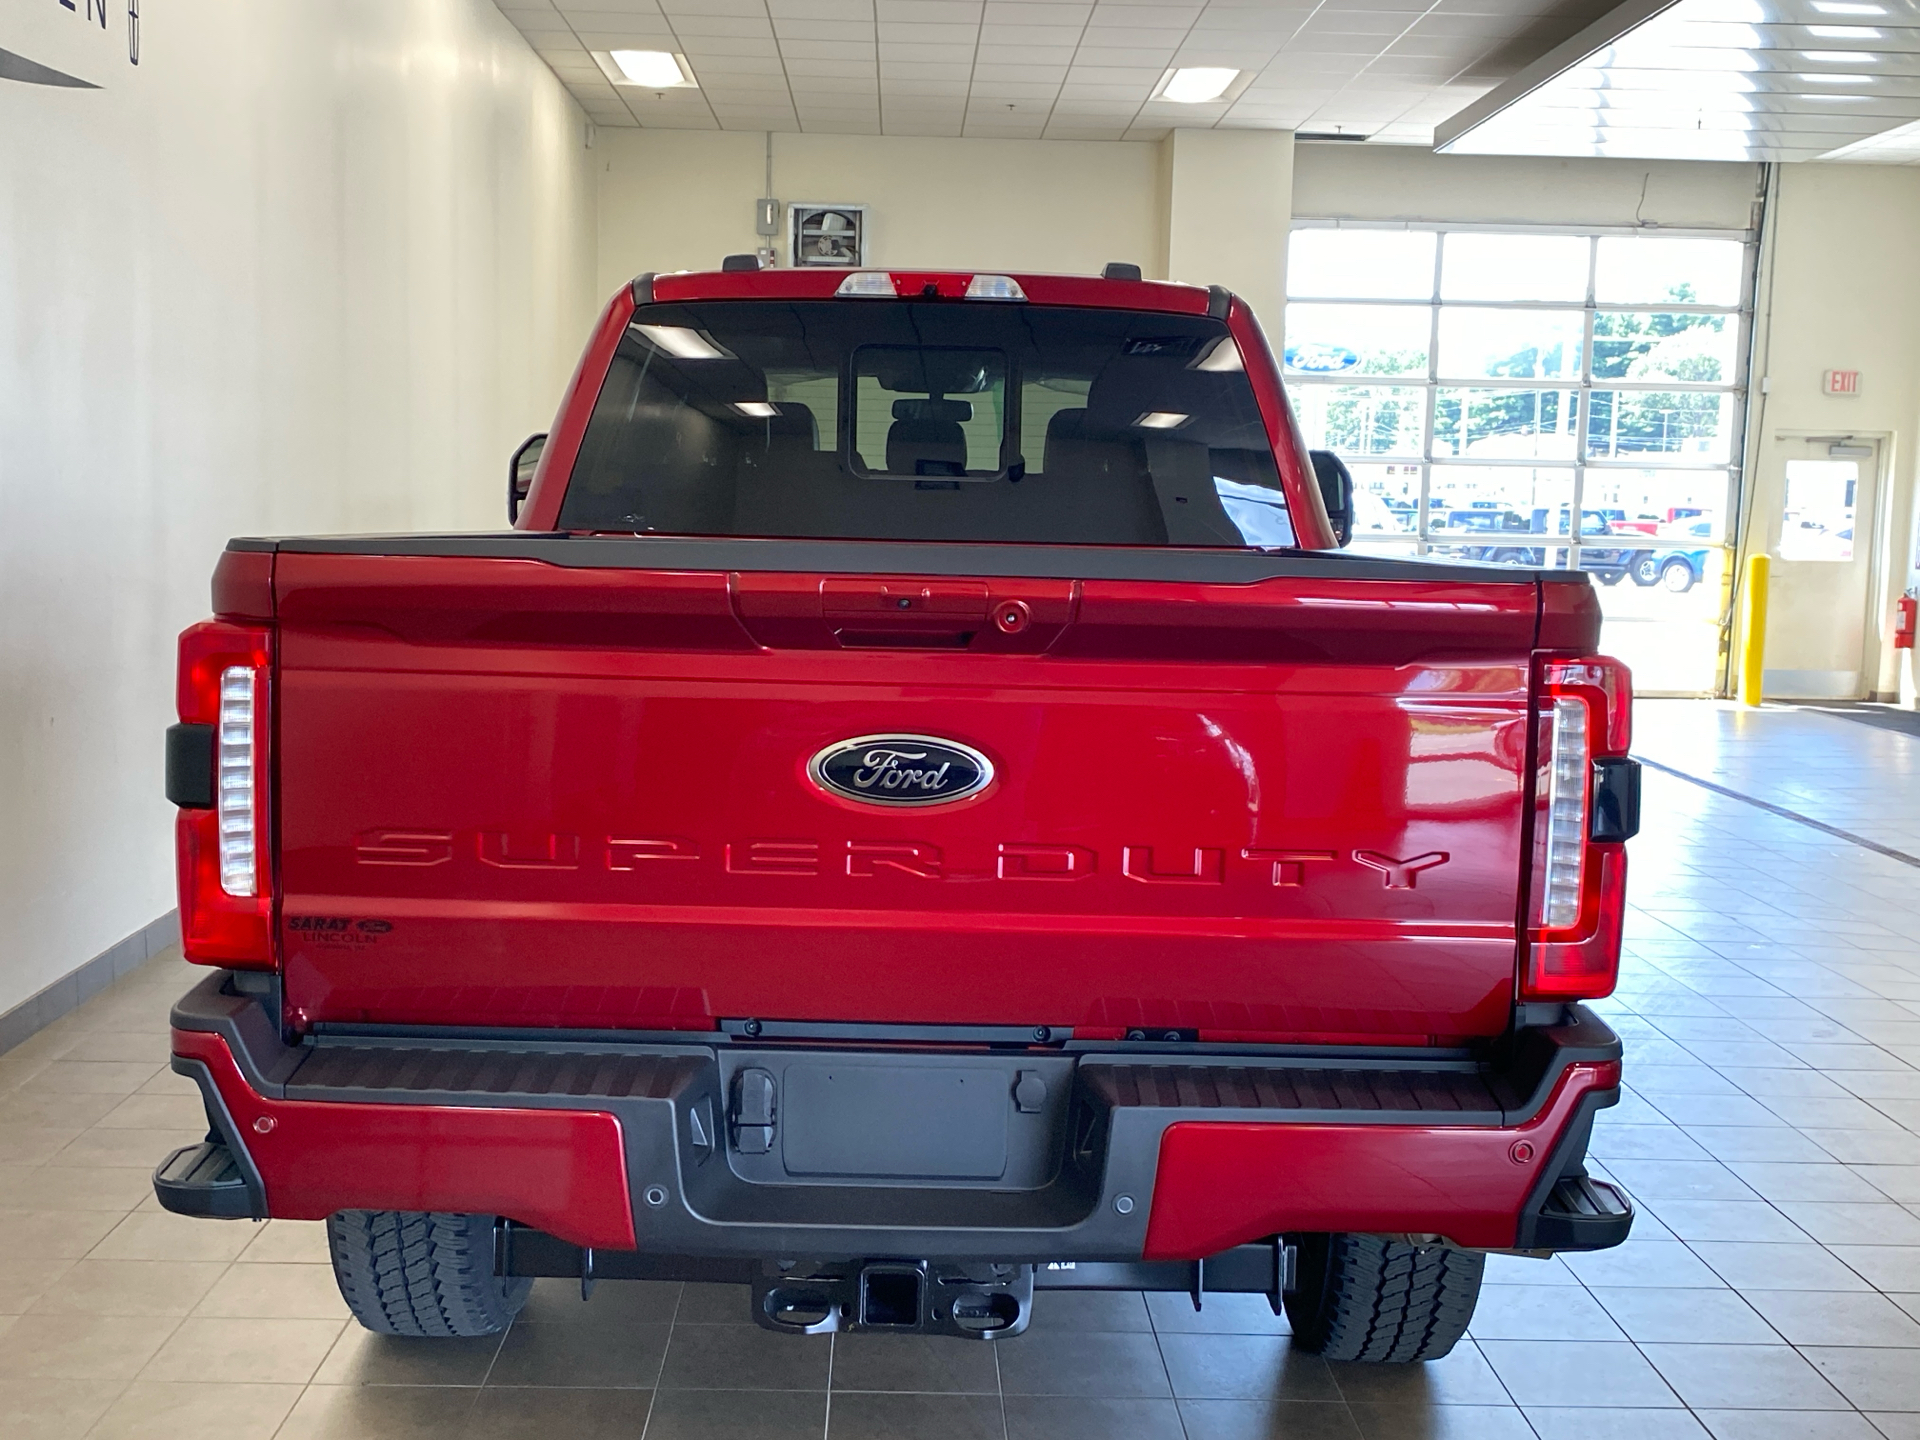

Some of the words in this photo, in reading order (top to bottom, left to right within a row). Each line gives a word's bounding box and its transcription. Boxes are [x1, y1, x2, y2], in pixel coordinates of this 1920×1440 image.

[1830, 370, 1859, 393] EXIT
[853, 749, 951, 790] Ford
[356, 828, 943, 879] SUPER
[997, 843, 1451, 890] DUTY
[303, 931, 378, 944] LINCOLN
